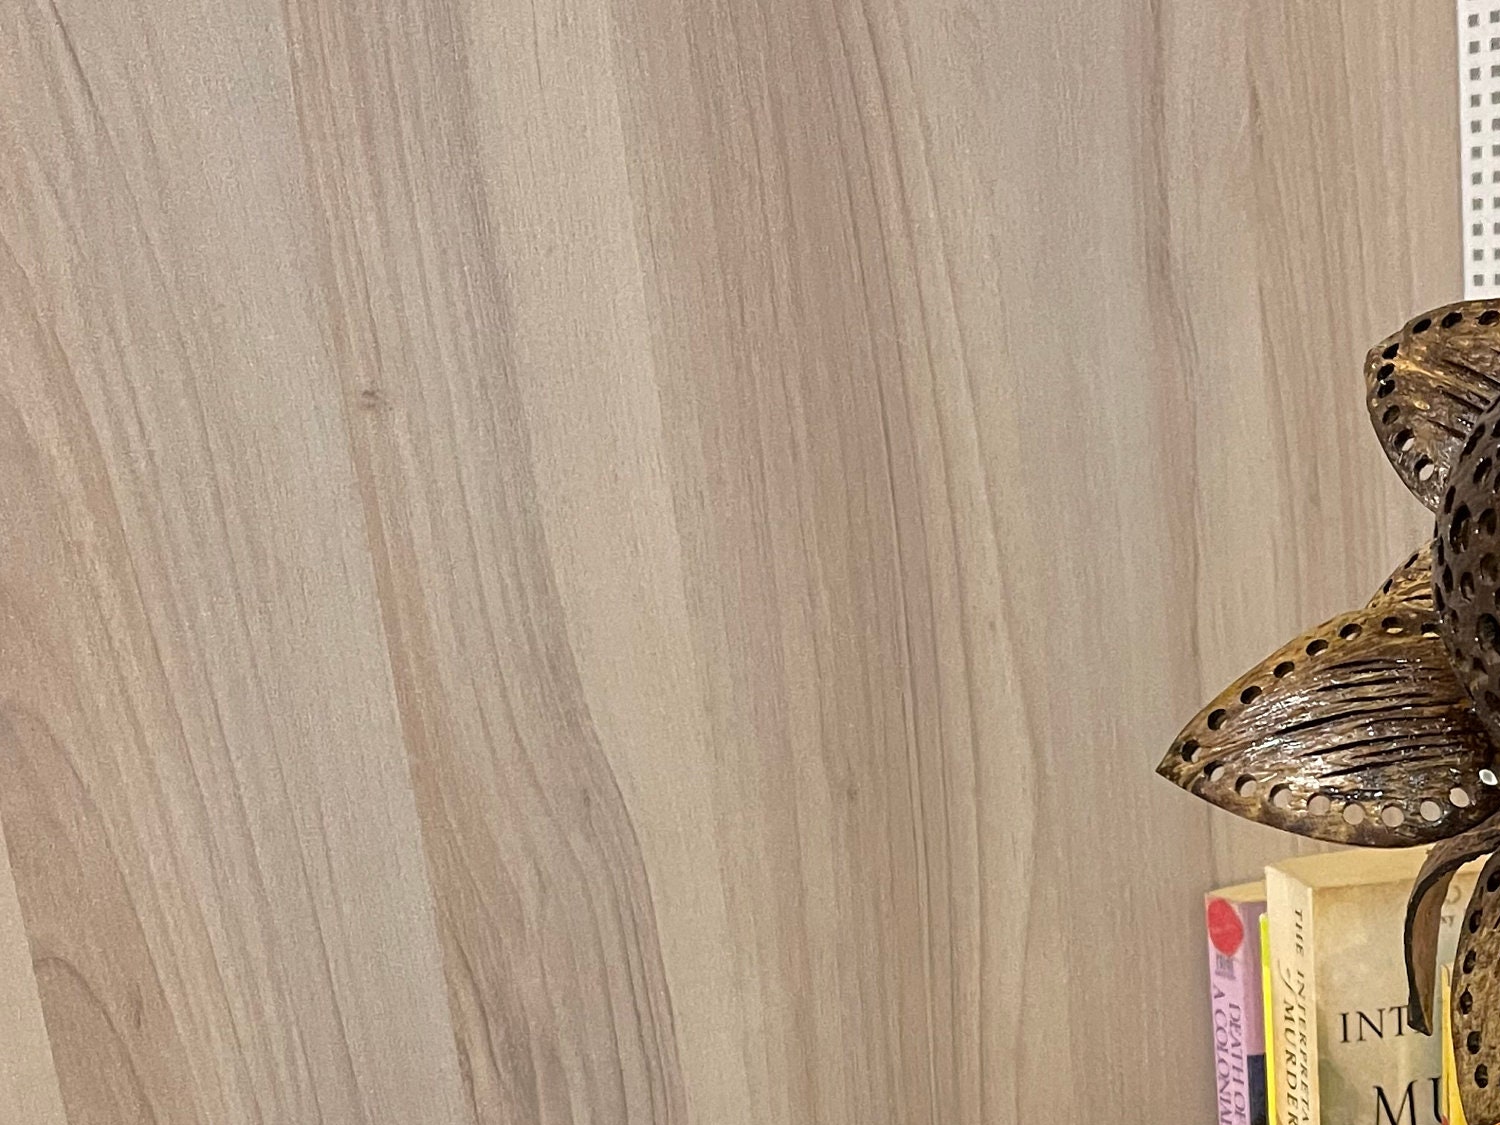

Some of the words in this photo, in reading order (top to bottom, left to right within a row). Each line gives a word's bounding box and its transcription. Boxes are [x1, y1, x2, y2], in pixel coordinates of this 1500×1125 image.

[1295, 909, 1304, 957] THE
[1213, 984, 1225, 999] A
[1215, 1008, 1233, 1125] COLONIAL
[1228, 1003, 1244, 1089] DEATH
[1234, 1092, 1246, 1125] OF
